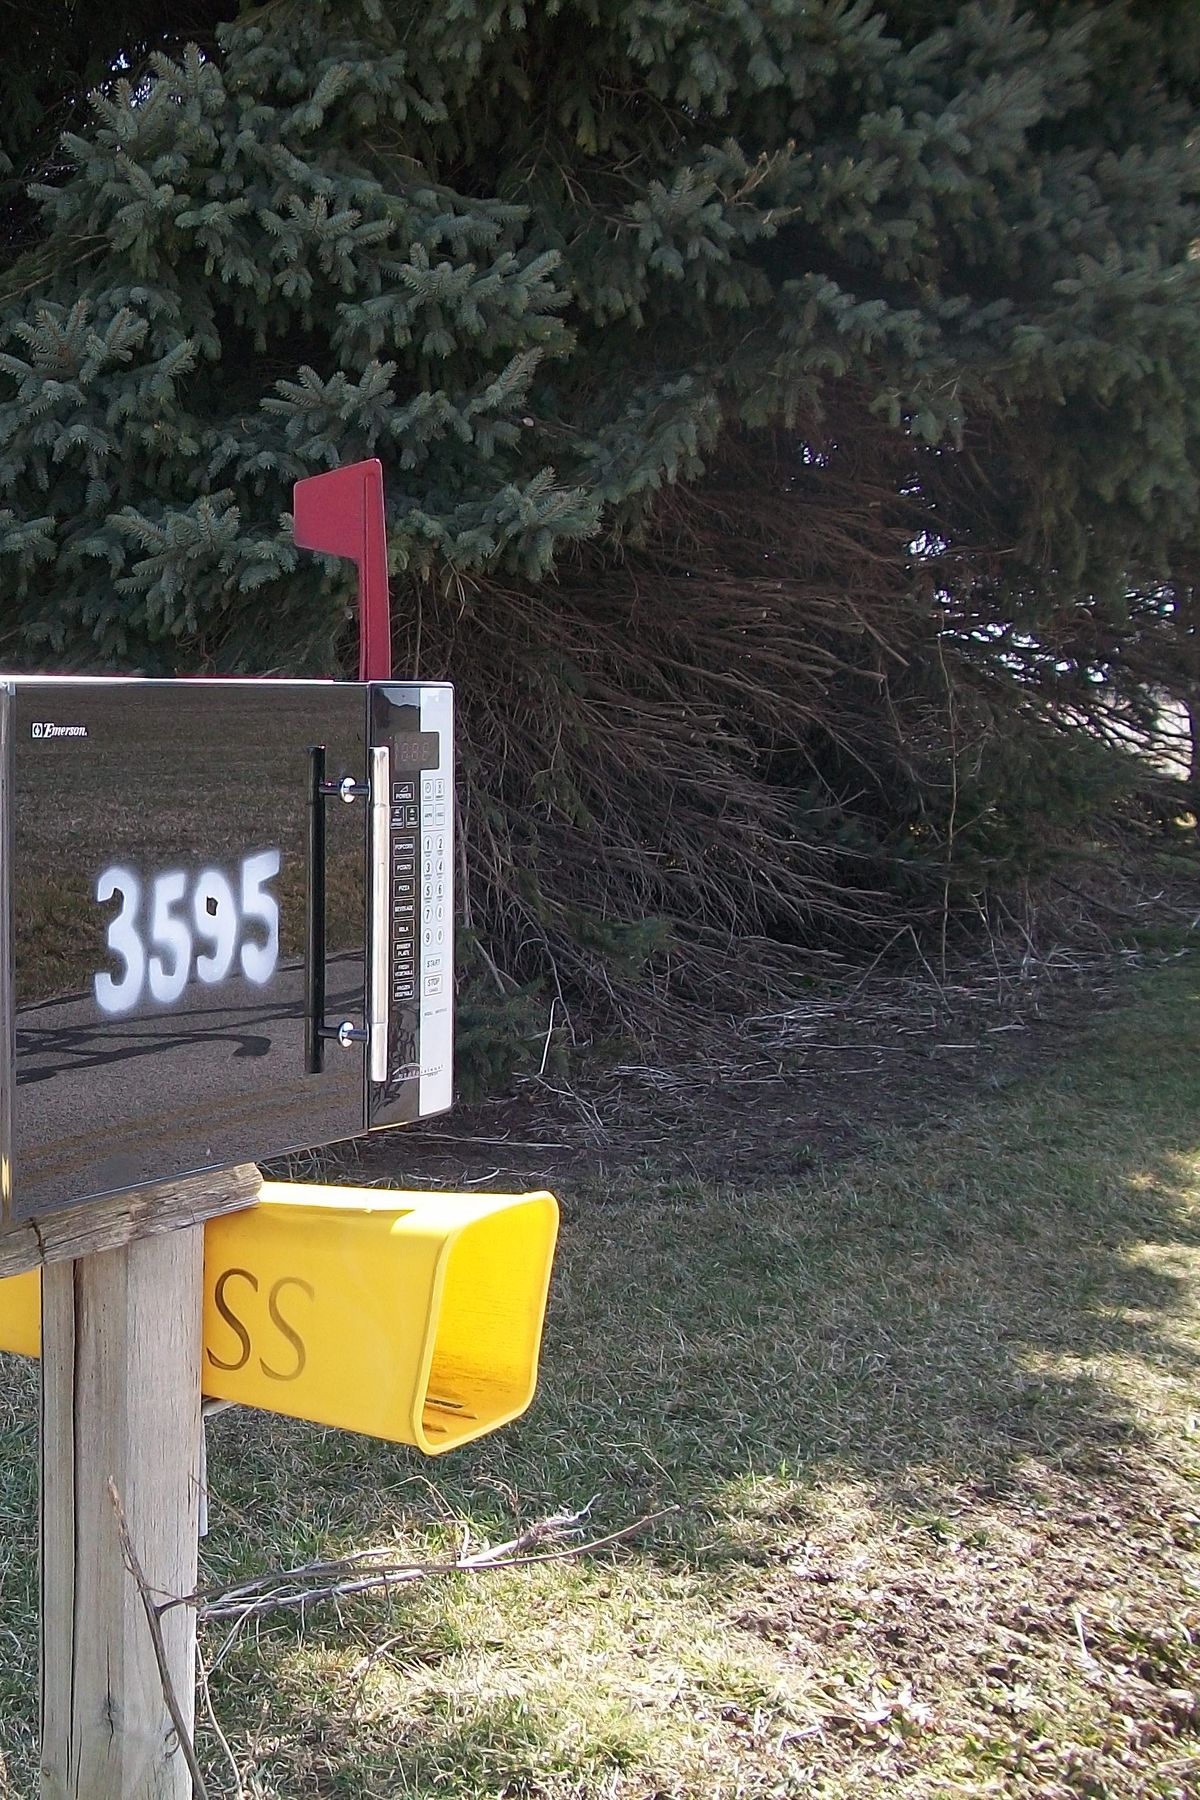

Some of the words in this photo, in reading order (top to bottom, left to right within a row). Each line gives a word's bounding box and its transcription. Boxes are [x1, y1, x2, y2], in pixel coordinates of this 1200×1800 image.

[94, 849, 281, 1013] 3595
[426, 959, 441, 968] START
[427, 977, 440, 987] STOP
